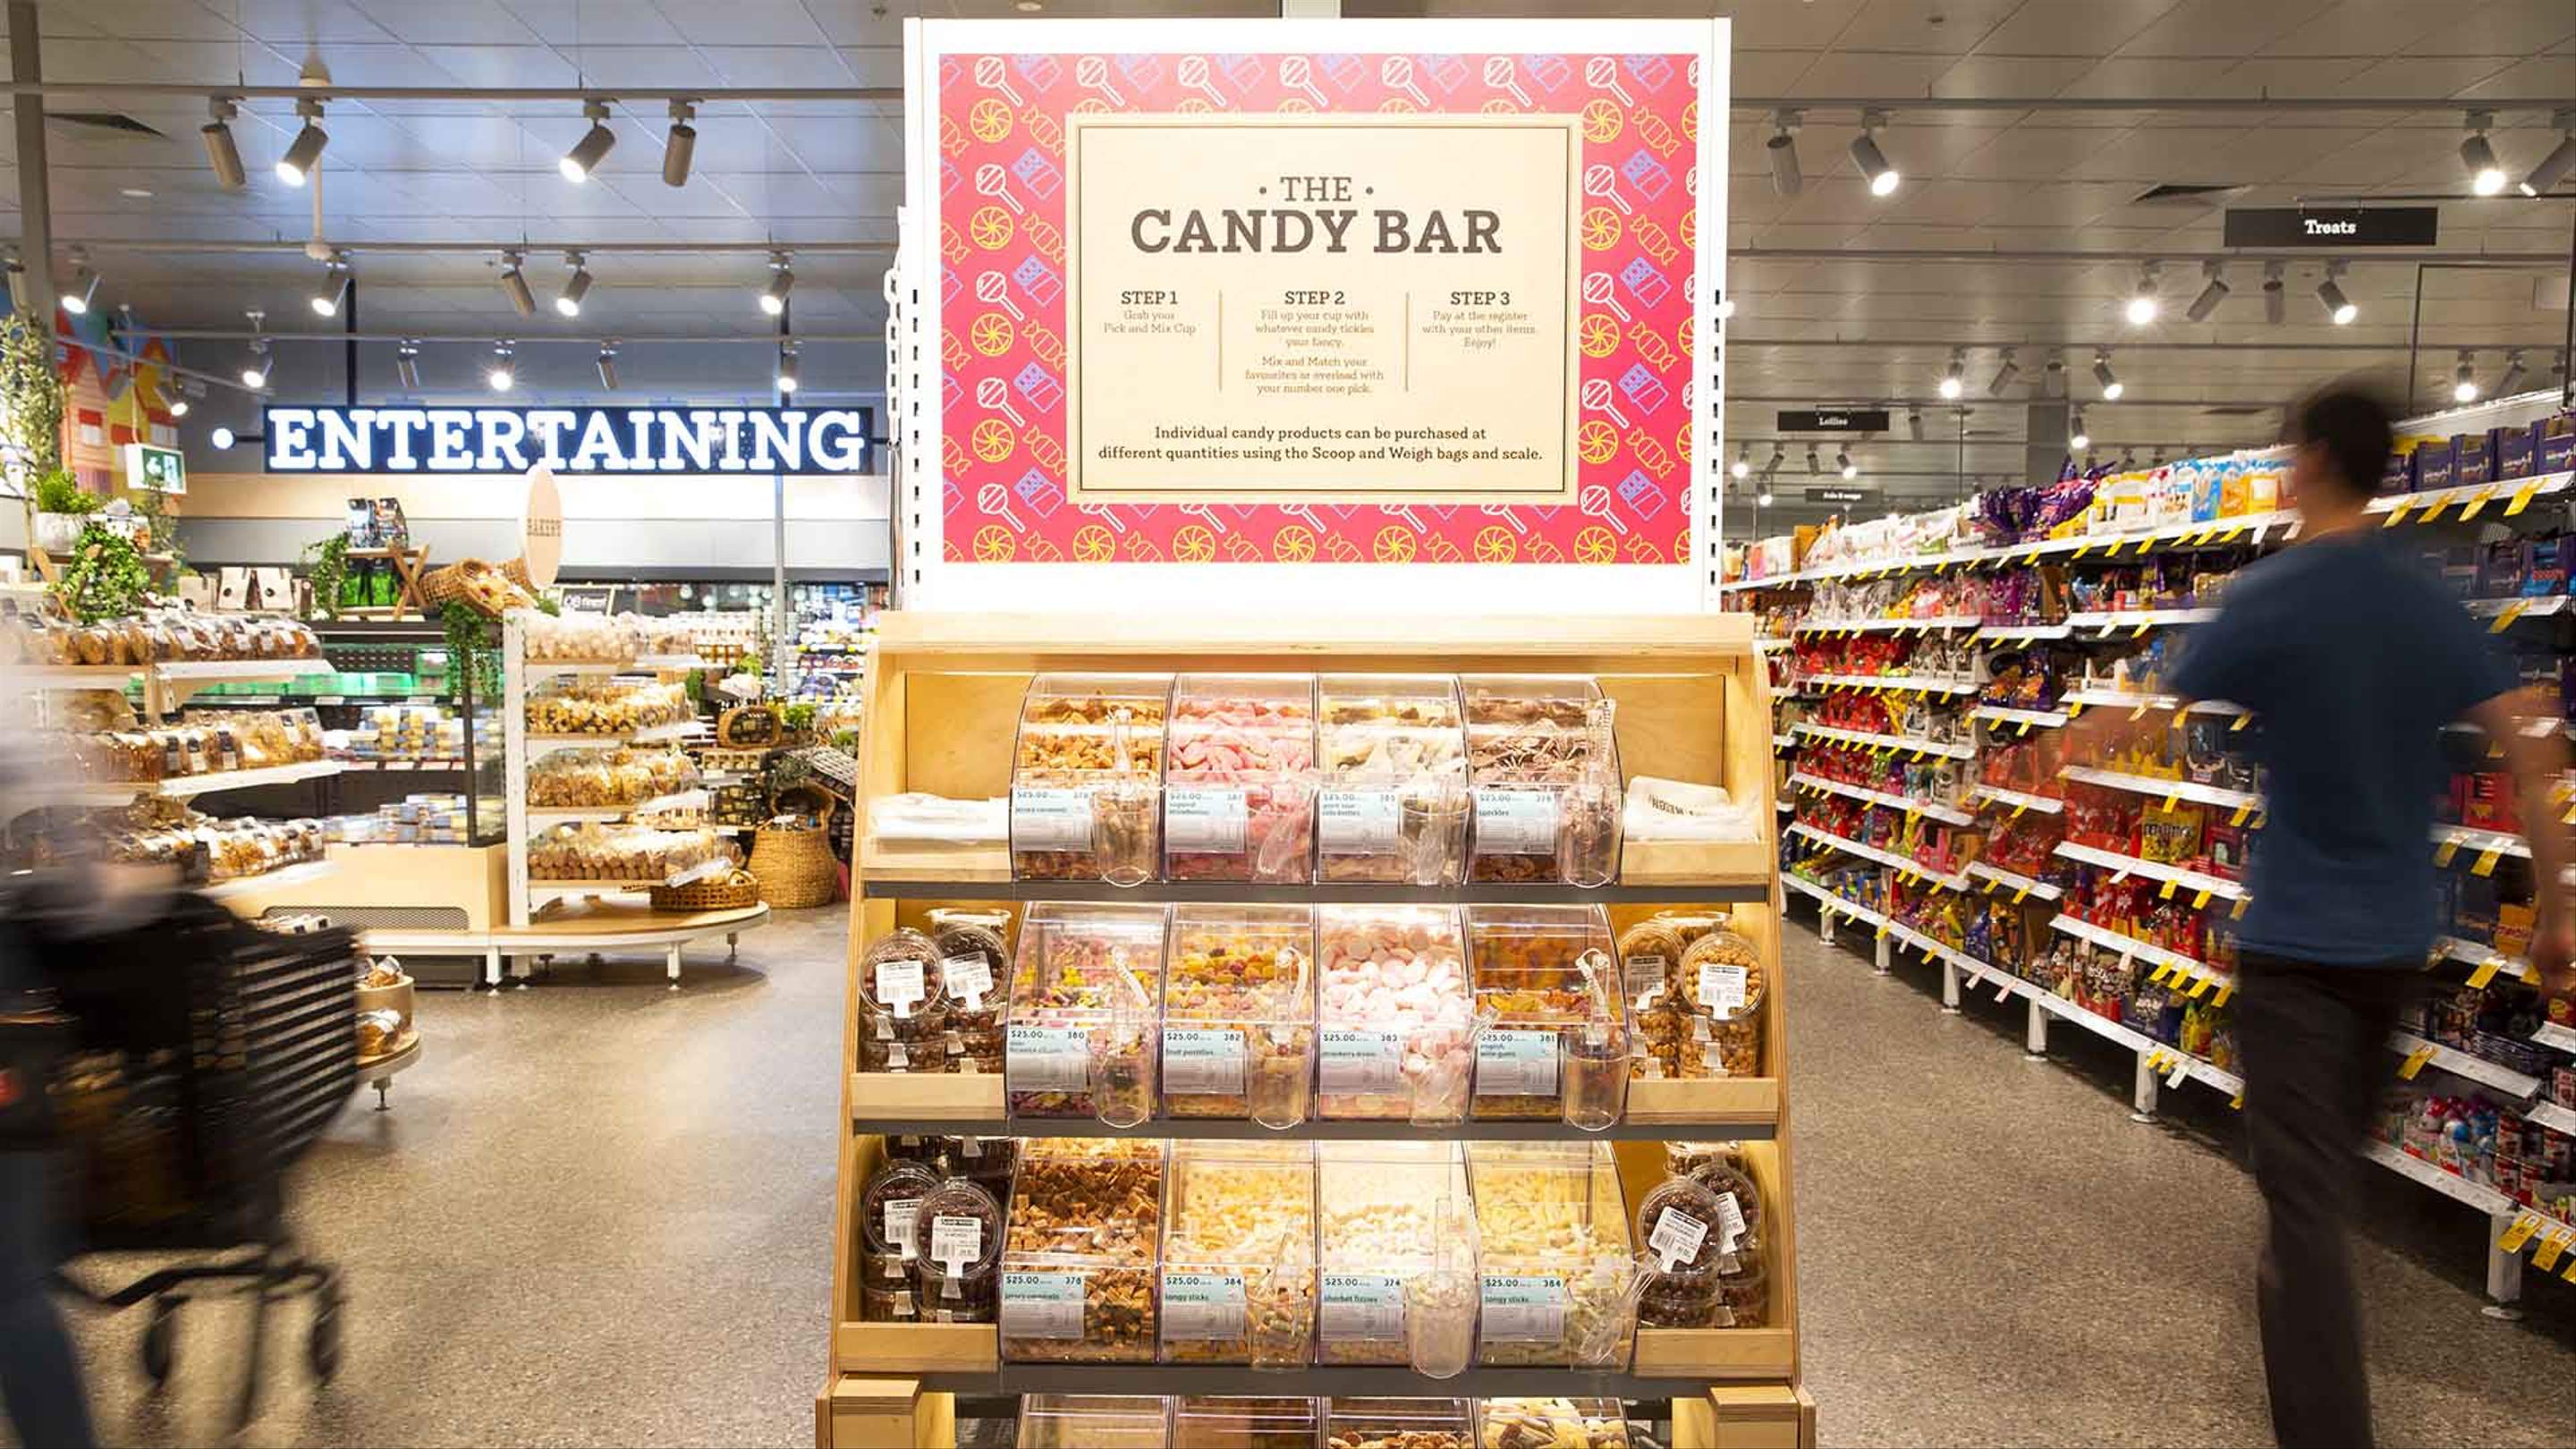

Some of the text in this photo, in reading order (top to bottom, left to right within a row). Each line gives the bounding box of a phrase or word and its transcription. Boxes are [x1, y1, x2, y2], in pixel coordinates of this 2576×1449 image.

[1279, 175, 1352, 203] THE
[1131, 208, 1503, 254] CANDY BAR
[2304, 219, 2357, 234] Treats
[1120, 291, 1180, 306] STEP 1
[1284, 291, 1346, 306] STEP 2
[1450, 292, 1512, 307] STEP 3
[1123, 309, 1176, 323] Grab your
[1260, 309, 1369, 324] Fill up your cup with
[1433, 310, 1529, 324] Pay at the register
[1103, 322, 1197, 337] Pick and Mix Cup
[1254, 323, 1375, 337] whatever candy tickles
[1421, 323, 1447, 335] with
[1448, 326, 1472, 337] your
[1474, 323, 1504, 335] other
[1284, 336, 1343, 350] your fancy.
[1463, 336, 1496, 351] Enjoy!
[1261, 355, 1368, 369] Mix and Match your
[1244, 369, 1385, 381] favourites or overload with
[1256, 383, 1372, 396] your number one pick.
[267, 409, 865, 470] ENTERTAINING
[1155, 426, 1487, 442] Individual candy products can be purchased at
[1097, 445, 1544, 462] different quantities using the Scoop and Weigh bags and scale.
[1011, 1030, 1044, 1039] $25.00
[1166, 1032, 1199, 1042] $25.00
[1323, 1033, 1356, 1042] $25.00
[1005, 1275, 1039, 1284] $25.00
[1165, 1275, 1199, 1286] $25.00
[1325, 1277, 1359, 1287] $25.00
[1485, 1278, 1519, 1288] $25.00
